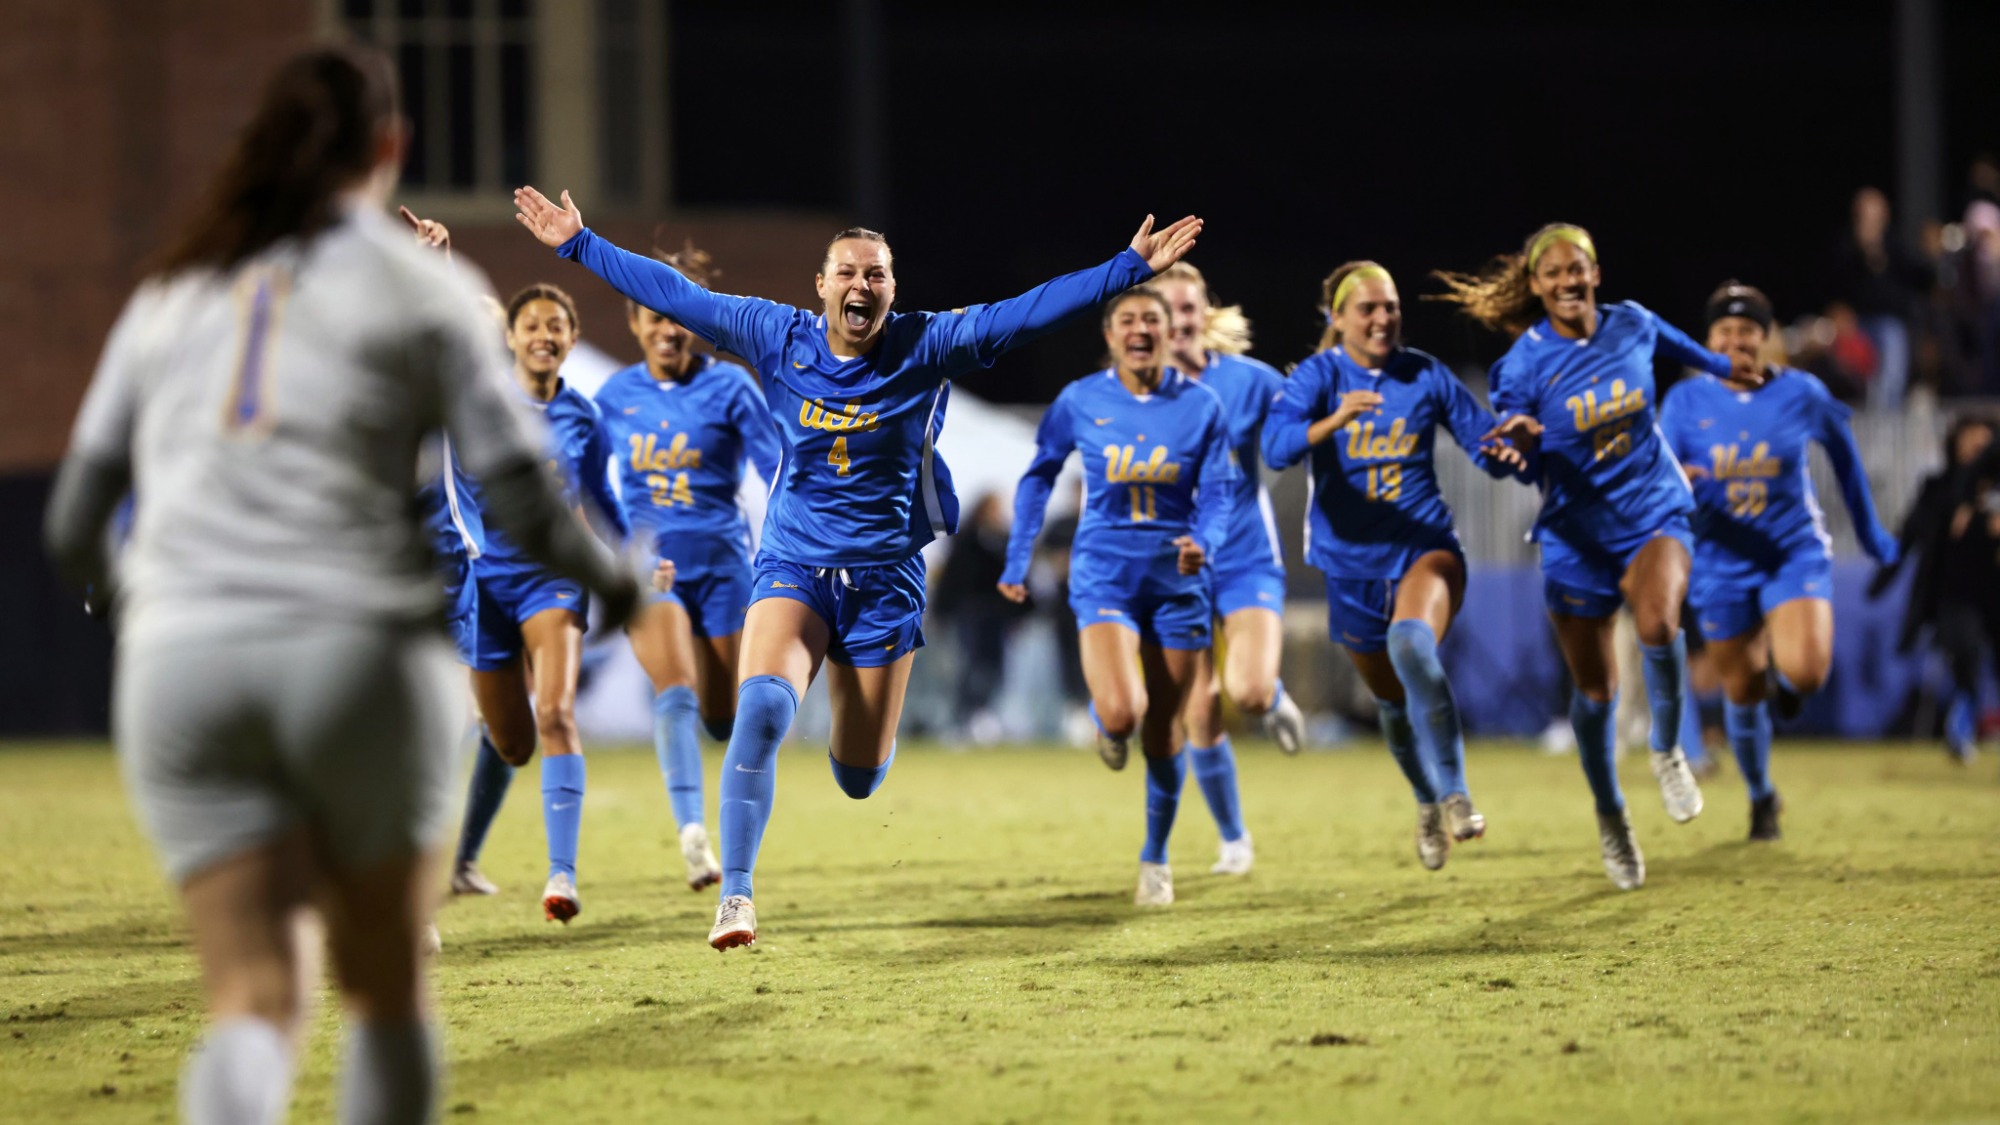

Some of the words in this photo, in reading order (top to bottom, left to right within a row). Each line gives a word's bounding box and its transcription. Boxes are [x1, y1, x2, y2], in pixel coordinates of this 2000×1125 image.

[800, 397, 880, 432] Ucla
[1566, 379, 1646, 432] Ucla
[630, 433, 702, 471] Ucla
[827, 436, 851, 477] 4
[1345, 418, 1419, 459] Ucla
[1104, 445, 1180, 483] Ucla
[647, 473, 695, 506] 24
[1129, 486, 1157, 522] 11
